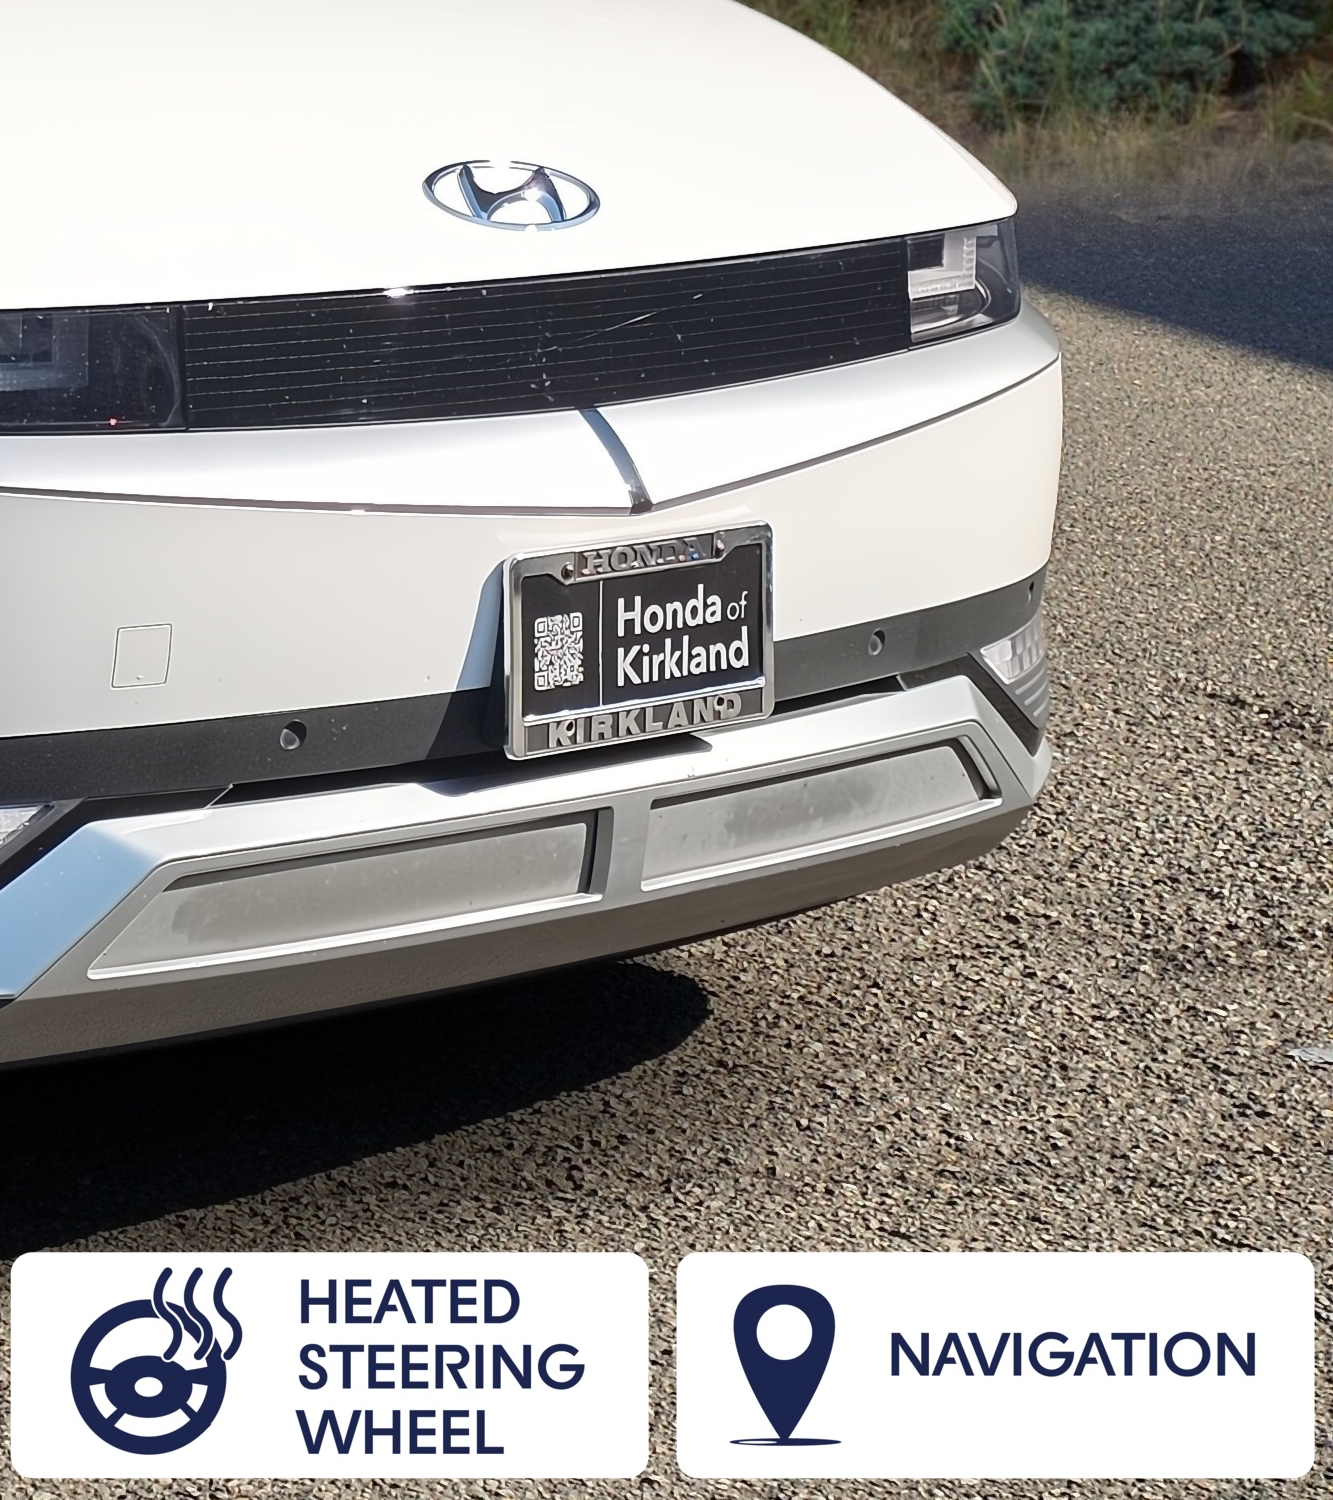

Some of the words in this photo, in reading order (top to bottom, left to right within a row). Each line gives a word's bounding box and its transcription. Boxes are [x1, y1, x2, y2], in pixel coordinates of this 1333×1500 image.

[583, 536, 706, 573] HONDA
[616, 583, 722, 637] Honda
[726, 590, 749, 621] of
[616, 626, 750, 687] Kirkland
[548, 692, 742, 749] KIRKLAND
